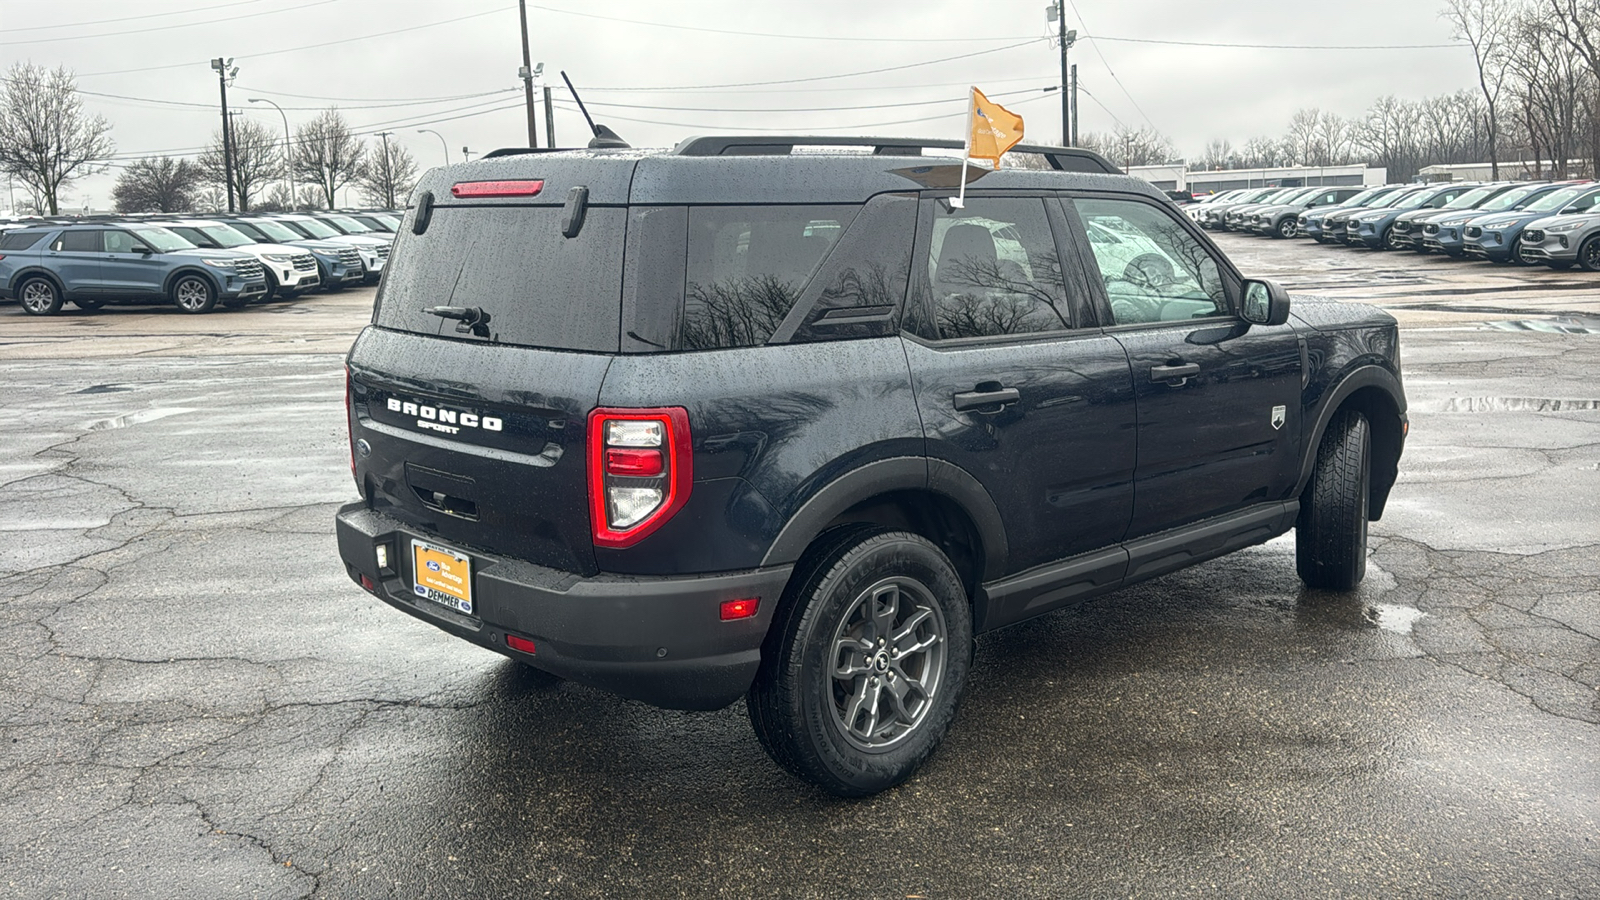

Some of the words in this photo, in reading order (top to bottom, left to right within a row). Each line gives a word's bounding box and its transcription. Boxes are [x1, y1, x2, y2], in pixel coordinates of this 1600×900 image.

[387, 398, 502, 431] BRONCO
[417, 420, 460, 434] SPORT
[427, 589, 459, 608] DEMMER
